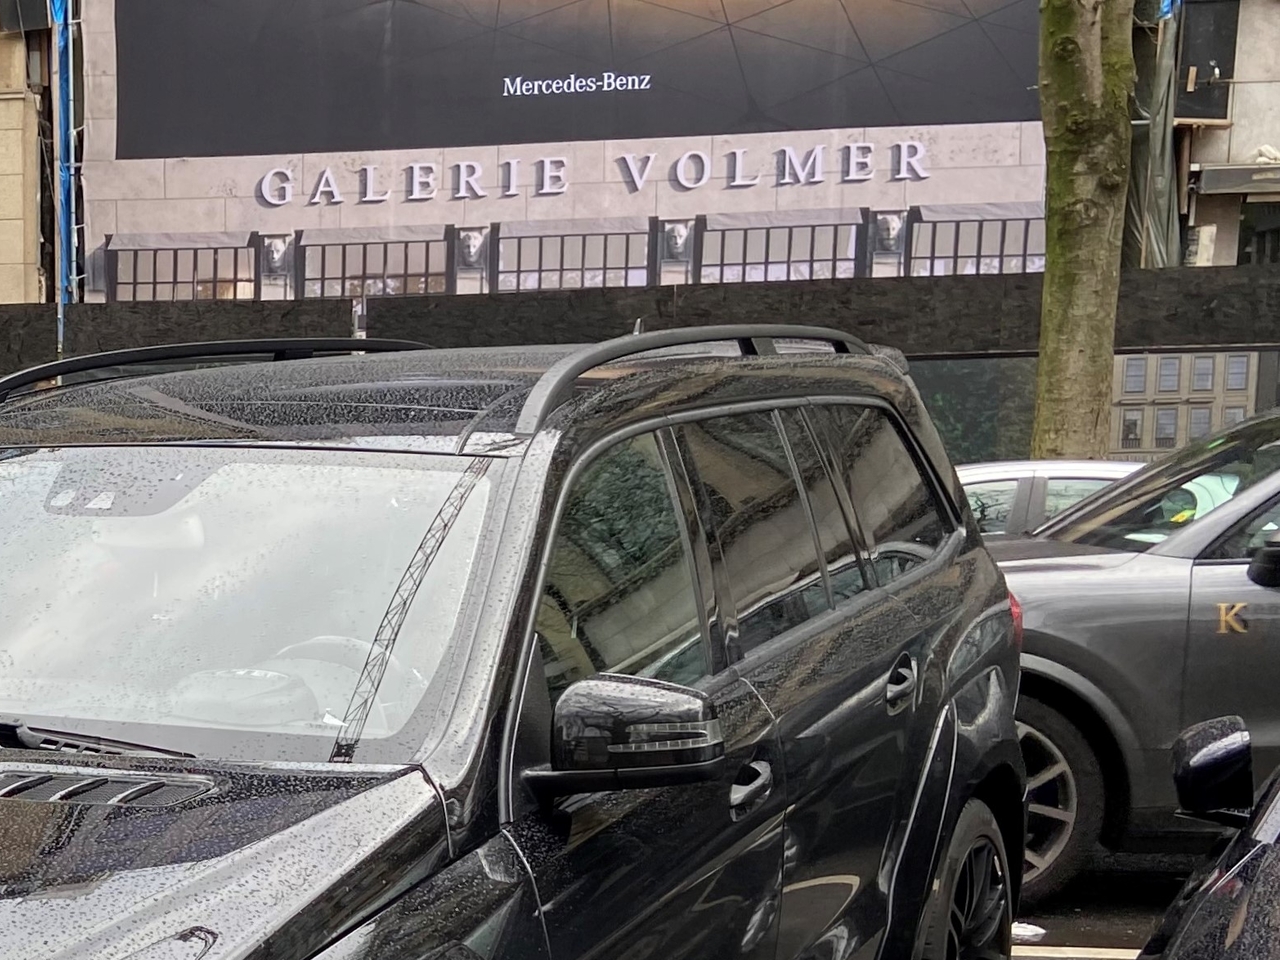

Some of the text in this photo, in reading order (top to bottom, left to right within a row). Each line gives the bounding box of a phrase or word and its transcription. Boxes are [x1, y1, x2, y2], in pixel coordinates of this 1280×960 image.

[502, 71, 652, 97] Mercedes-Benz
[257, 140, 932, 208] GALERIE VOLMER
[1216, 602, 1249, 634] K
